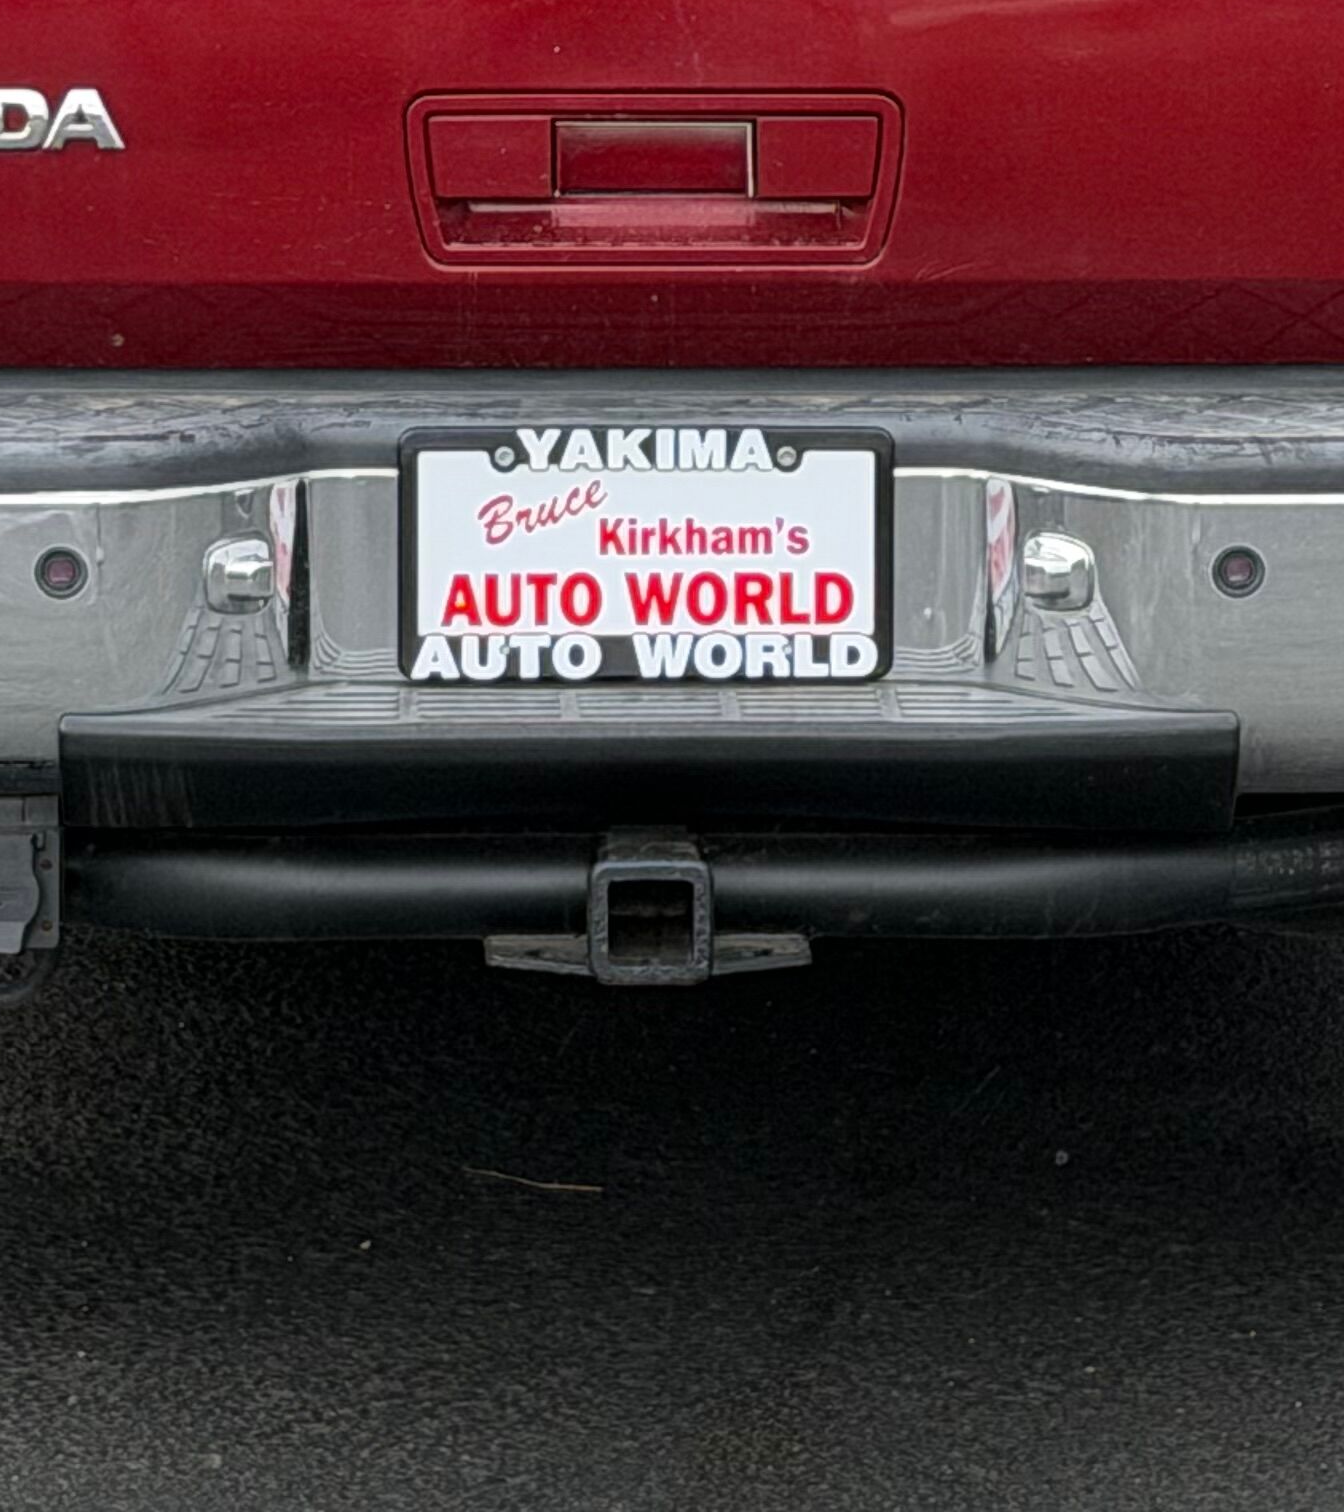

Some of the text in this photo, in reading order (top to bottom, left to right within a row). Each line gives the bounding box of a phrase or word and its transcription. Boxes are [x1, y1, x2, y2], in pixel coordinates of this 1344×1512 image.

[515, 427, 775, 471] YAKIMA
[477, 479, 609, 545] Bruce
[597, 516, 811, 556] Kirkham's
[440, 571, 855, 627] AUTO WORLD
[410, 632, 879, 680] AUTO WORLD
